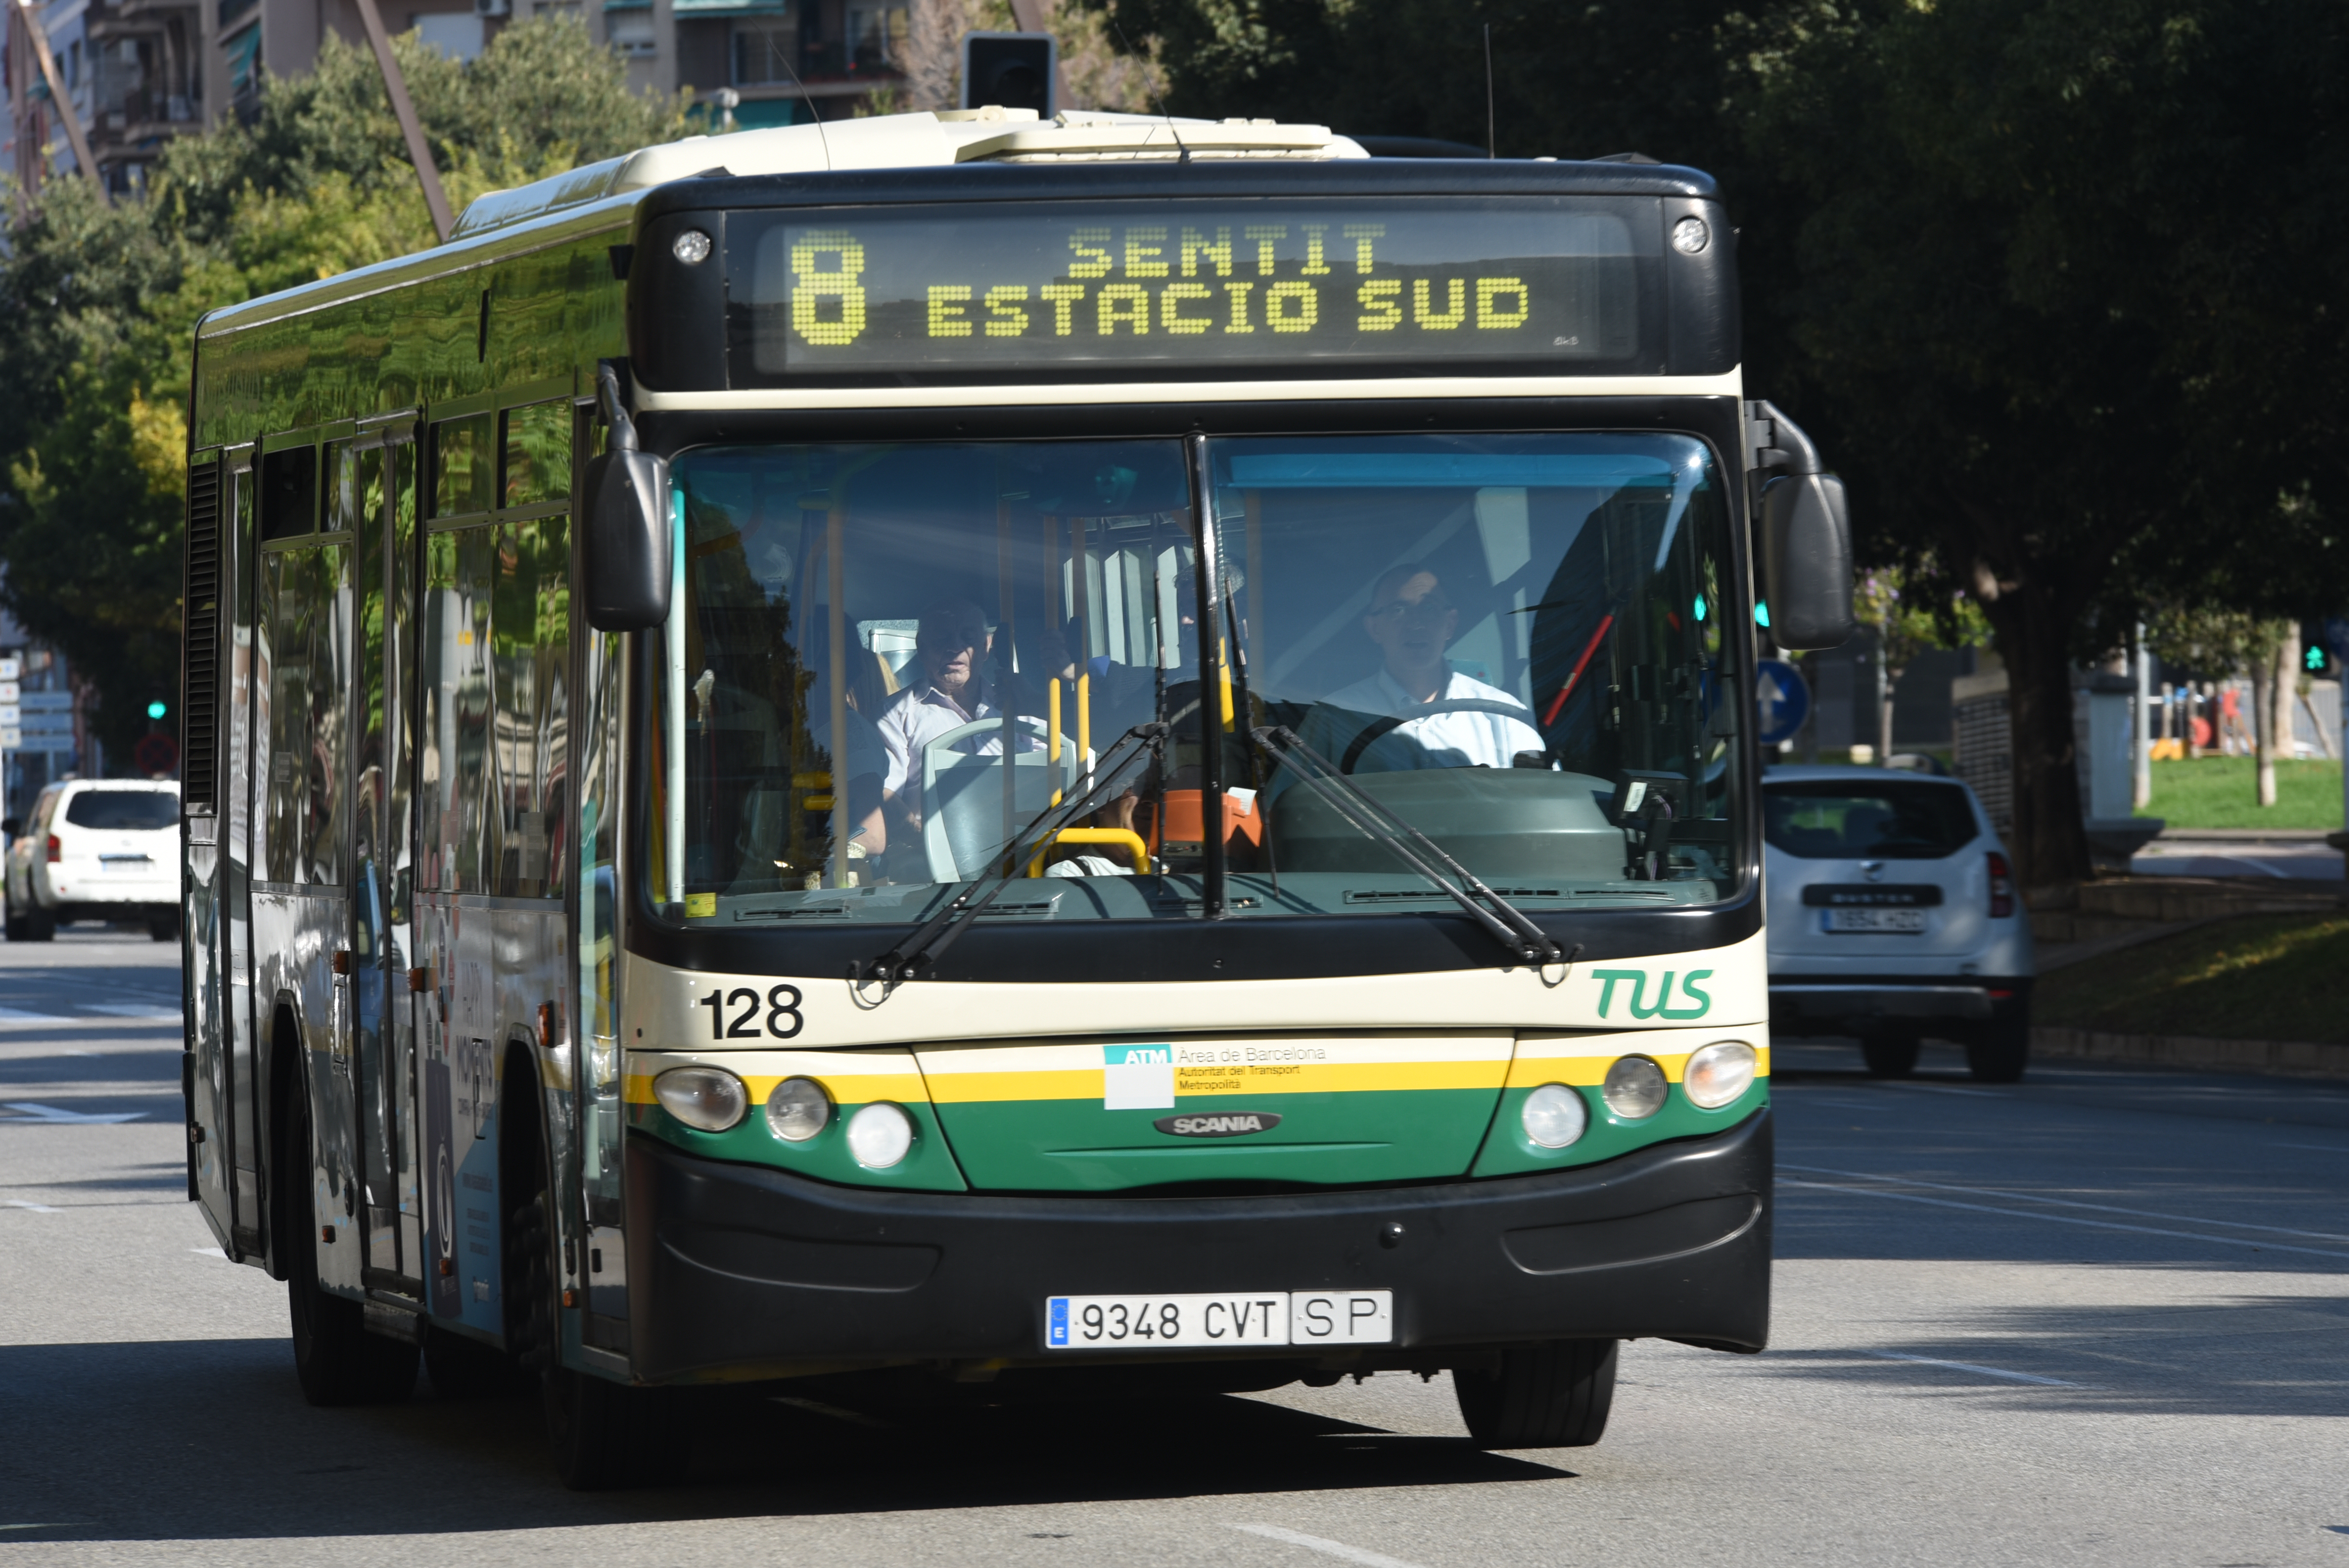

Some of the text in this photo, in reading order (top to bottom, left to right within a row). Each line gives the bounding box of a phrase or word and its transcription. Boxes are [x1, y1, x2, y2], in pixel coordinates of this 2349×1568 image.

[1069, 224, 1386, 277] SENTIT
[791, 231, 866, 345] 8
[928, 277, 1528, 338] ESTACIO SUD
[1591, 969, 1715, 1019] TUS
[700, 984, 804, 1039] 128
[1125, 1049, 1168, 1064] ATM
[1177, 1046, 1326, 1063] Àrea de Barcelona
[1178, 1065, 1301, 1077] Autoritat del Transport
[1179, 1079, 1241, 1091] Metropolità
[1173, 1115, 1263, 1133] SCANIA
[1054, 1326, 1065, 1338] E
[1083, 1303, 1180, 1340] 9348
[1205, 1301, 1276, 1338] CVT
